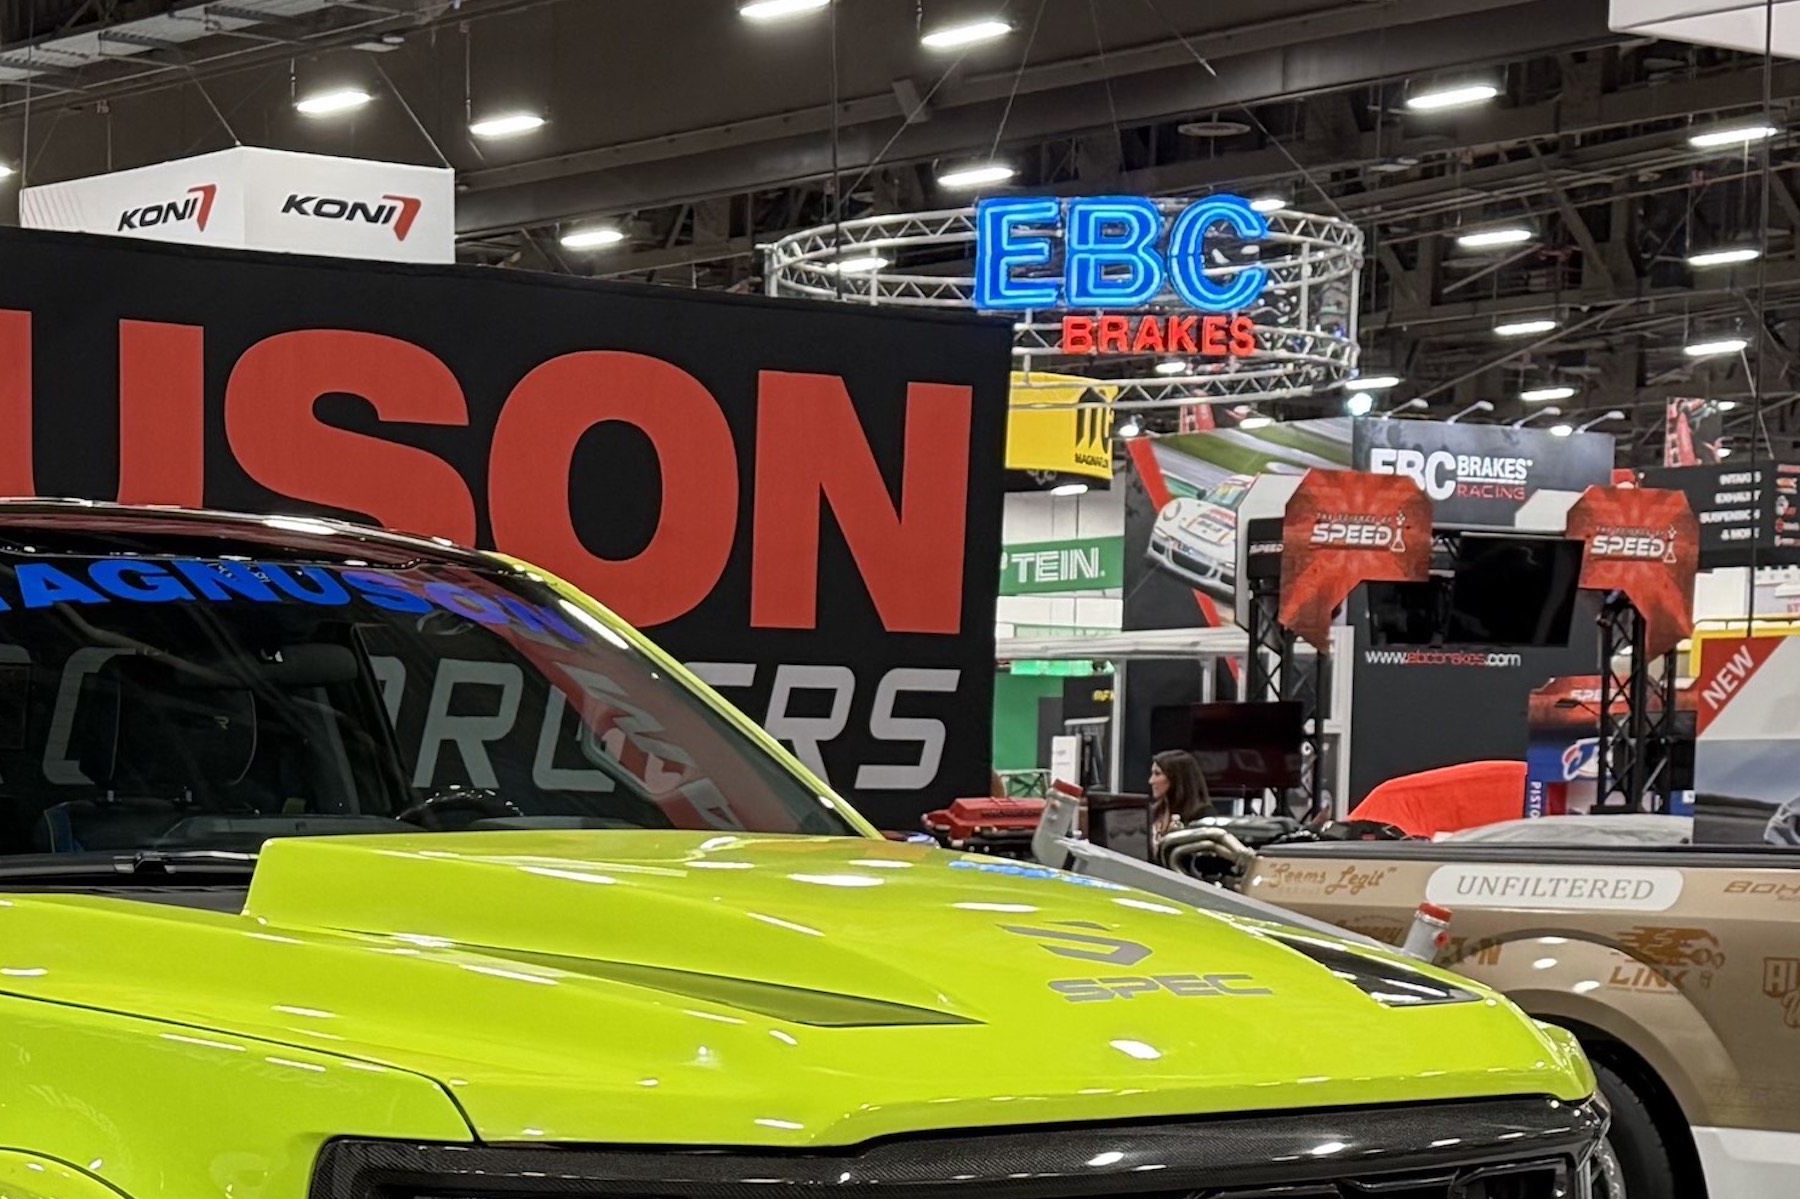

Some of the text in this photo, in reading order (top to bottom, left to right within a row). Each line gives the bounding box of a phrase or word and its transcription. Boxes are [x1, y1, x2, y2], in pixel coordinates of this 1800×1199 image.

[117, 199, 198, 232] KONI
[281, 193, 396, 225] KONI
[974, 193, 1268, 312] EBC
[1062, 315, 1256, 357] BRAKES
[1371, 448, 1456, 500] EBC
[1457, 484, 1527, 500] RACING
[1310, 522, 1392, 545] SPEED
[1590, 535, 1665, 557] SPEED
[1365, 650, 1521, 667] www.ebcbrakes.com
[1702, 644, 1754, 710] NEW
[1457, 875, 1655, 900] UNFILTERED
[1048, 973, 1273, 1003] SPEC
